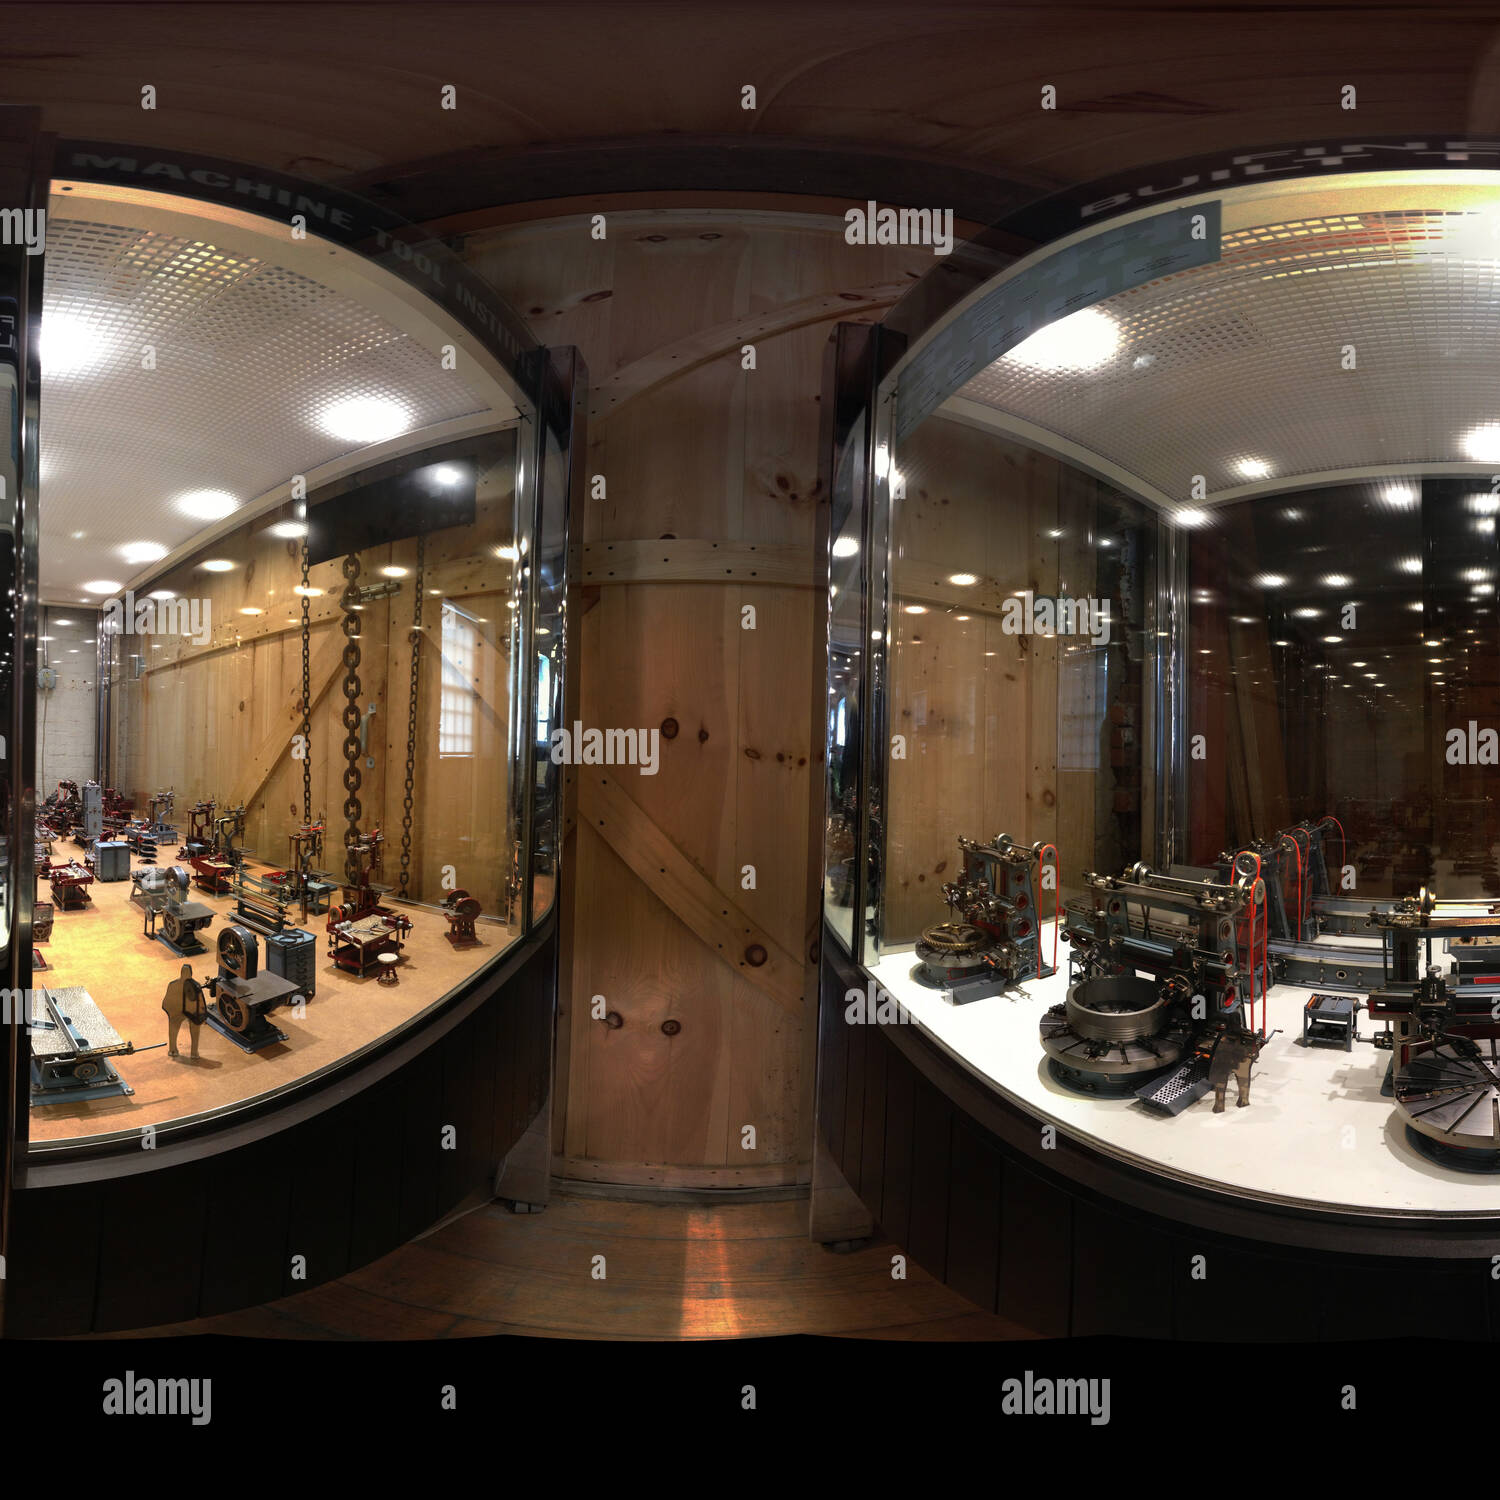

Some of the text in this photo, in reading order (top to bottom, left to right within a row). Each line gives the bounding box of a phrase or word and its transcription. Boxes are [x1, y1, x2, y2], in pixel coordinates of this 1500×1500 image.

[71, 152, 354, 231] MACHINE
[371, 224, 446, 289] TOOL
[1080, 152, 1373, 218] BUILT
